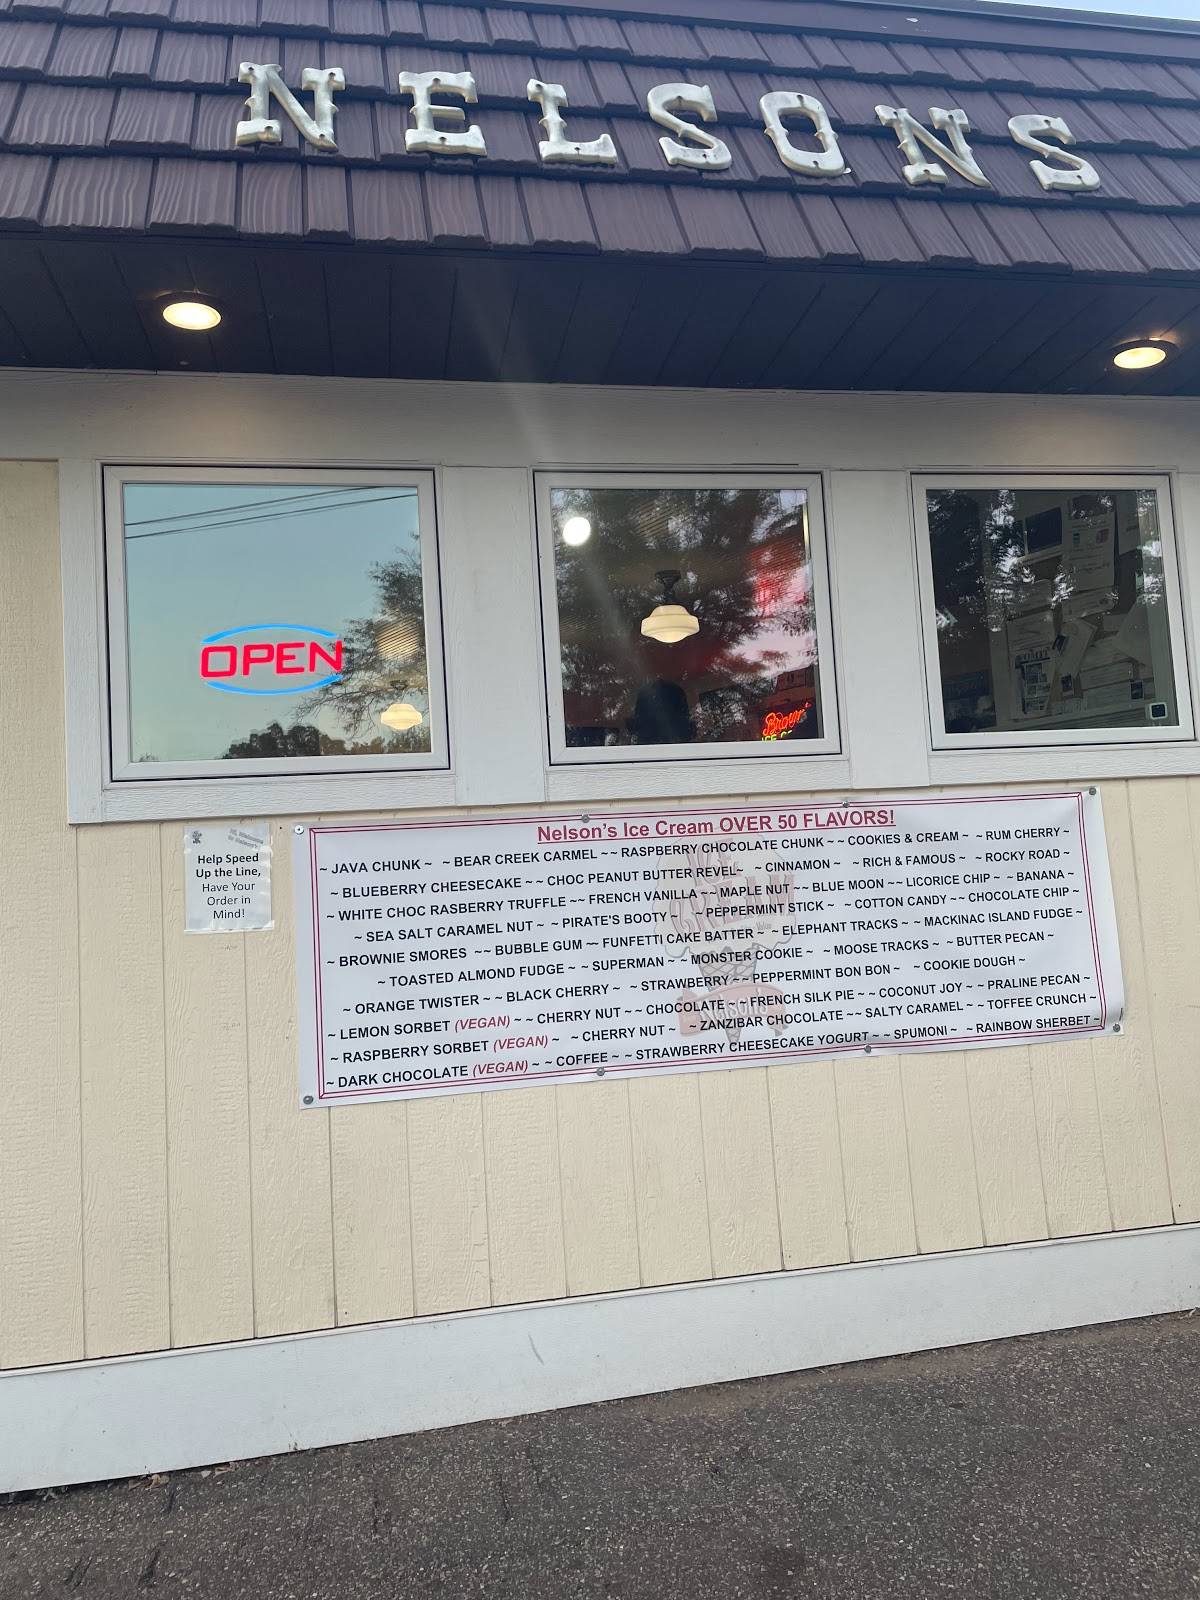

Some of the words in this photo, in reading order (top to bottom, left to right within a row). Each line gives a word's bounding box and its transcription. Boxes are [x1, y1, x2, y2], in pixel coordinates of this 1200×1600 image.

[235, 61, 1101, 192] NELSONS
[200, 640, 343, 678] OPEN
[331, 862, 368, 874] JAVA
[372, 859, 421, 872] CHUNK
[454, 855, 491, 867] BEAR
[494, 852, 540, 865] CREEK
[543, 849, 598, 862] CARMEL
[621, 844, 698, 858] RASPBERRY
[701, 839, 778, 854] CHOCOLATE
[781, 837, 824, 849] CHUNK
[848, 834, 901, 846] COOKIES
[904, 833, 913, 844] &
[916, 831, 959, 843] CREAM
[986, 830, 1012, 841] RUM
[1014, 827, 1060, 839] CHERRY
[538, 823, 618, 842] Nelson's
[624, 822, 650, 837] Ice
[656, 820, 714, 836] Cream
[720, 816, 772, 832] OVER
[778, 814, 797, 830] 50
[803, 810, 894, 828] FLAVORS!
[196, 868, 211, 879] Up
[214, 868, 232, 877] the
[235, 867, 261, 878] Line,
[197, 854, 222, 865] Help
[225, 853, 259, 864] Speed
[342, 883, 427, 898] BLUEBERRY
[430, 877, 522, 893] CHEESECAKE
[547, 874, 584, 886] CHOC
[588, 871, 639, 884] PEANUT
[642, 867, 693, 881] BUTTER
[696, 866, 737, 878] REVEL
[765, 859, 830, 872] CINNAMON
[862, 856, 892, 868] RICH
[894, 856, 903, 866] &
[905, 853, 956, 866] FAMOUS
[985, 850, 1026, 862] ROCKY
[1028, 848, 1060, 860] ROAD
[202, 883, 229, 892] Have
[231, 882, 255, 891] Your
[207, 896, 238, 906] Order
[241, 896, 251, 904] in
[338, 908, 383, 921] WHITE
[386, 905, 426, 918] CHOC
[430, 900, 504, 916] RASBERRY
[507, 896, 566, 910] TRUFFLE
[589, 891, 641, 905] FRENCH
[643, 888, 698, 902] VANILLA
[720, 885, 762, 898] MAPLE
[766, 883, 790, 896] NUT
[812, 880, 845, 892] BLUE
[848, 878, 884, 890] MOON
[906, 874, 960, 887] LICORICE
[963, 873, 990, 884] CHIP
[1016, 869, 1065, 882] BANANA
[213, 909, 245, 919] Mind!
[339, 952, 405, 967] BROWNIE
[409, 947, 467, 962] SMORES
[495, 941, 549, 956] BUBBLE
[552, 939, 582, 952] GUM
[602, 934, 663, 948] FUNFETTI
[666, 931, 701, 944] CAKE
[704, 928, 754, 942] BATTER
[782, 922, 847, 936] ELEPHANT
[849, 918, 898, 931] TRACKS
[924, 913, 985, 927] MACKINAC
[988, 910, 1030, 923] ISLAND
[1033, 907, 1073, 920] FUDGE
[366, 930, 394, 942] SEA
[398, 927, 433, 940] SALT
[436, 923, 503, 938] CARAMEL
[506, 920, 534, 933] NUT
[562, 914, 620, 928] PIRATE'S
[624, 911, 667, 924] BOOTY
[706, 902, 785, 920] PEPPERMINT
[788, 900, 824, 913] STICK
[854, 896, 904, 909] COTTON
[907, 894, 947, 906] CANDY
[968, 888, 1040, 902] CHOCOLATE
[1042, 886, 1070, 898] CHIP
[355, 999, 415, 1014] ORANGE
[418, 994, 480, 1010] TWISTER
[506, 988, 552, 1002] BLACK
[555, 984, 609, 998] CHERRY
[641, 975, 729, 992] STRAWBERRY
[752, 968, 832, 984] PEPPERMINT
[835, 966, 862, 978] BON
[865, 964, 890, 976] BON
[923, 958, 970, 971] COOKIE
[973, 955, 1016, 968] DOUGH
[389, 972, 454, 987] TOASTED
[458, 967, 516, 982] ALMOND
[519, 963, 565, 977] FUDGE
[592, 956, 664, 972] SUPERMAN
[691, 950, 752, 965] MONSTER
[755, 947, 803, 960] COOKIE
[834, 942, 878, 956] MOOSE
[880, 939, 929, 952] TRACKS
[956, 934, 1002, 947] BUTTER
[1004, 931, 1044, 944] PECAN
[340, 1025, 390, 1040] LEMON
[394, 1020, 451, 1035] SORBET
[455, 1016, 510, 1033] (VEGAN)
[537, 1009, 591, 1024] CHERRY
[595, 1007, 621, 1020] NUT
[646, 999, 725, 1015] CHOCOLATE
[750, 993, 801, 1008] FRENCH
[804, 991, 832, 1003] SILK
[835, 989, 855, 1001] PIE
[879, 984, 936, 998] COCONUT
[939, 982, 962, 994] JOY
[988, 976, 1038, 990] PRALINE
[1040, 974, 1080, 986] PECAN
[343, 1045, 429, 1064] RASPBERRY
[433, 1040, 489, 1056] SORBET
[493, 1035, 548, 1053] (VEGAN)
[582, 1027, 636, 1042] CHERRY
[639, 1024, 665, 1037] NUT
[700, 1016, 764, 1031] ZANZIBAR
[766, 1010, 844, 1026] CHOCOLATE
[865, 1005, 903, 1018] SALTY
[906, 1001, 964, 1015] CARAMEL
[986, 997, 1033, 1010] TOFFEE
[1036, 993, 1086, 1006] CRUNCH
[338, 1073, 378, 1088] DARK
[382, 1065, 468, 1084] CHOCOLATE
[472, 1060, 528, 1078] (VEGAN)
[556, 1052, 608, 1067] COFFEE
[636, 1042, 726, 1060] STRAWBERRY
[729, 1036, 814, 1052] CHEESECAKE
[817, 1031, 869, 1045] YOGURT
[894, 1025, 948, 1040] SPUMONI
[976, 1019, 1033, 1034] RAINBOW
[1036, 1014, 1091, 1029] SHERBET
